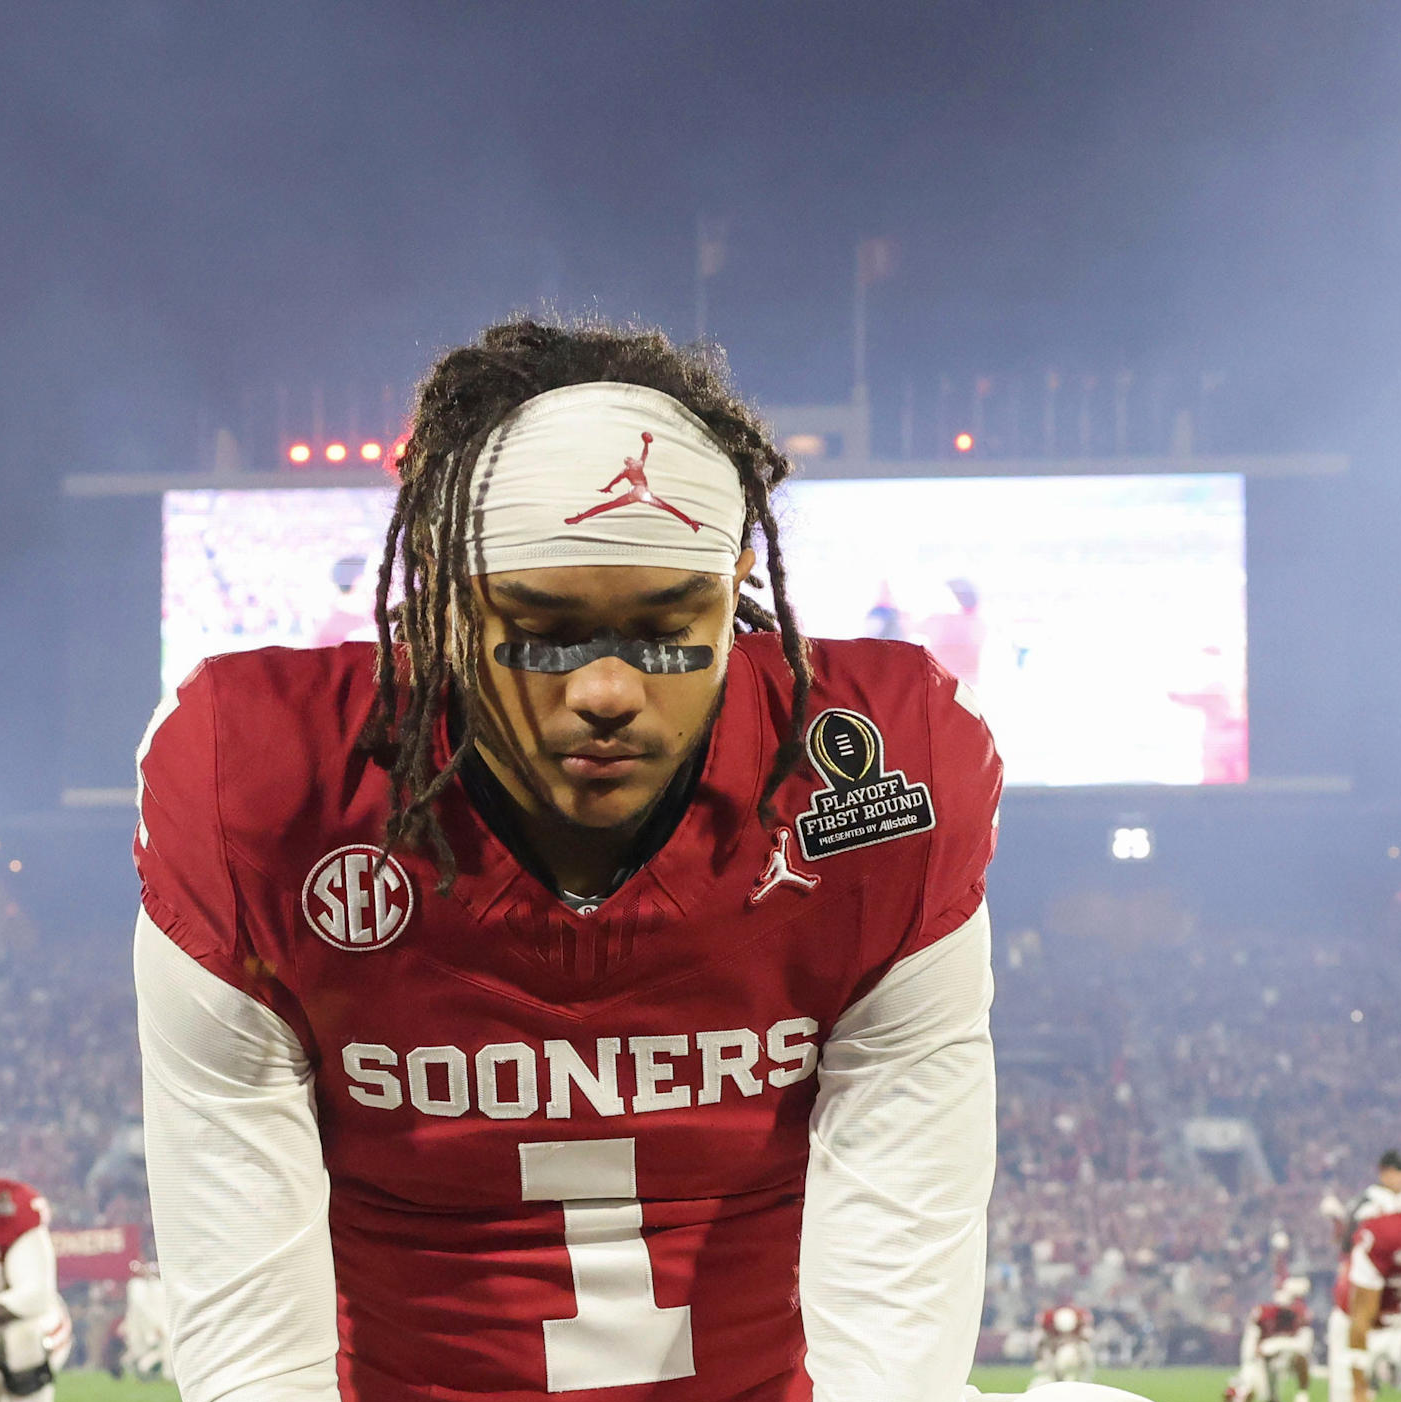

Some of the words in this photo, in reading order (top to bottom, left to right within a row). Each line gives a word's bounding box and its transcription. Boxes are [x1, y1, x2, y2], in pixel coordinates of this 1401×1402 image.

[804, 809, 860, 836] FIRST
[863, 791, 924, 820] ROUND
[818, 827, 865, 846] PRESENTED
[866, 823, 877, 833] BY
[878, 813, 918, 832] Allstate
[820, 779, 899, 813] PLAYOFF
[313, 853, 403, 943] SEC
[341, 1016, 820, 1120] SOONERS
[518, 1137, 697, 1394] 1
